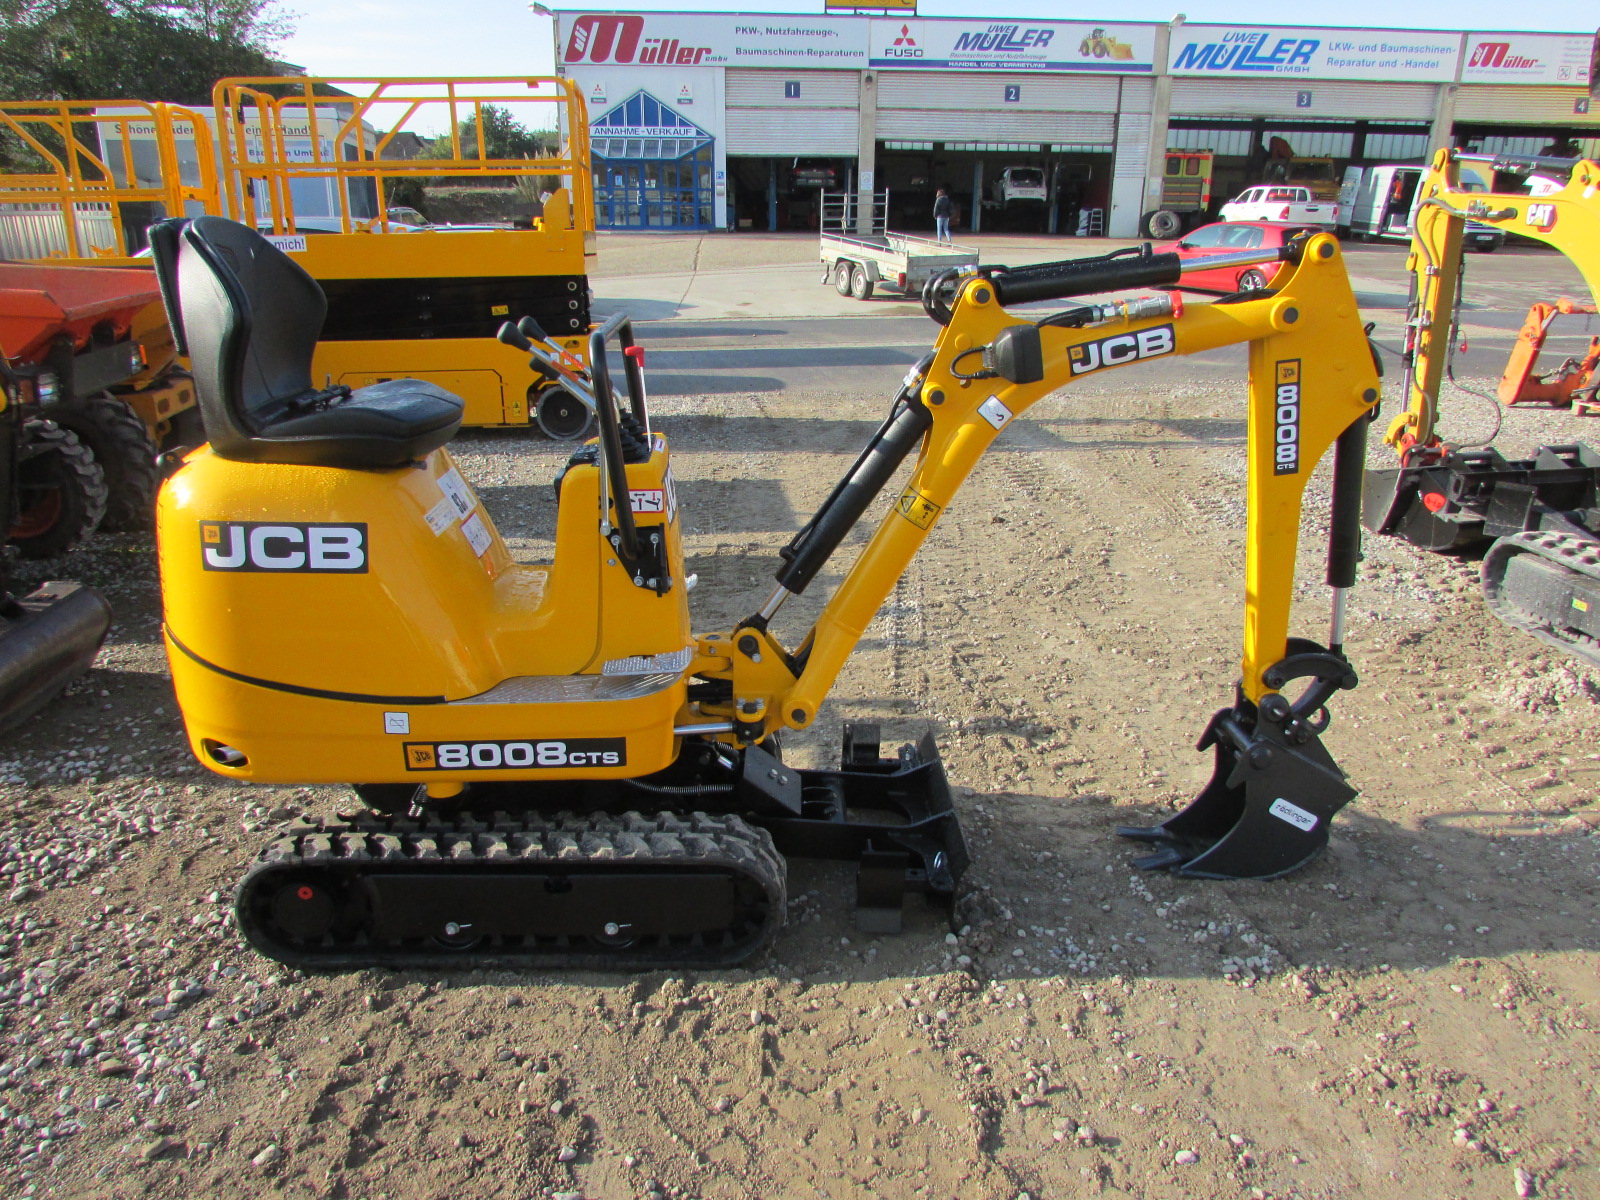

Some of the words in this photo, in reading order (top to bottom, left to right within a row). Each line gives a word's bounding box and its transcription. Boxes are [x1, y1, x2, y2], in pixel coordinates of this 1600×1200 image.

[987, 25, 1013, 34] UWE
[564, 15, 712, 64] Müller
[1222, 32, 1259, 43] UWE
[884, 49, 924, 58] FUSO
[1328, 42, 1355, 52] LKW-
[1358, 43, 1377, 52] und
[1380, 44, 1457, 55] Baumaschinen-
[1467, 42, 1539, 68] Müller
[1326, 58, 1376, 68] Reparatur
[1378, 59, 1398, 68] und
[1400, 60, 1440, 69] -Handel
[1009, 88, 1016, 100] 2
[1300, 94, 1308, 106] 3
[1577, 101, 1585, 112] 4
[114, 123, 157, 134] Shöne
[1526, 204, 1553, 226] CAT
[274, 238, 305, 250] mich!
[1072, 328, 1173, 374] JCB
[1276, 385, 1298, 463] 8008
[205, 526, 365, 569] JCB
[437, 742, 567, 768] 8008
[569, 751, 619, 765] CTS
